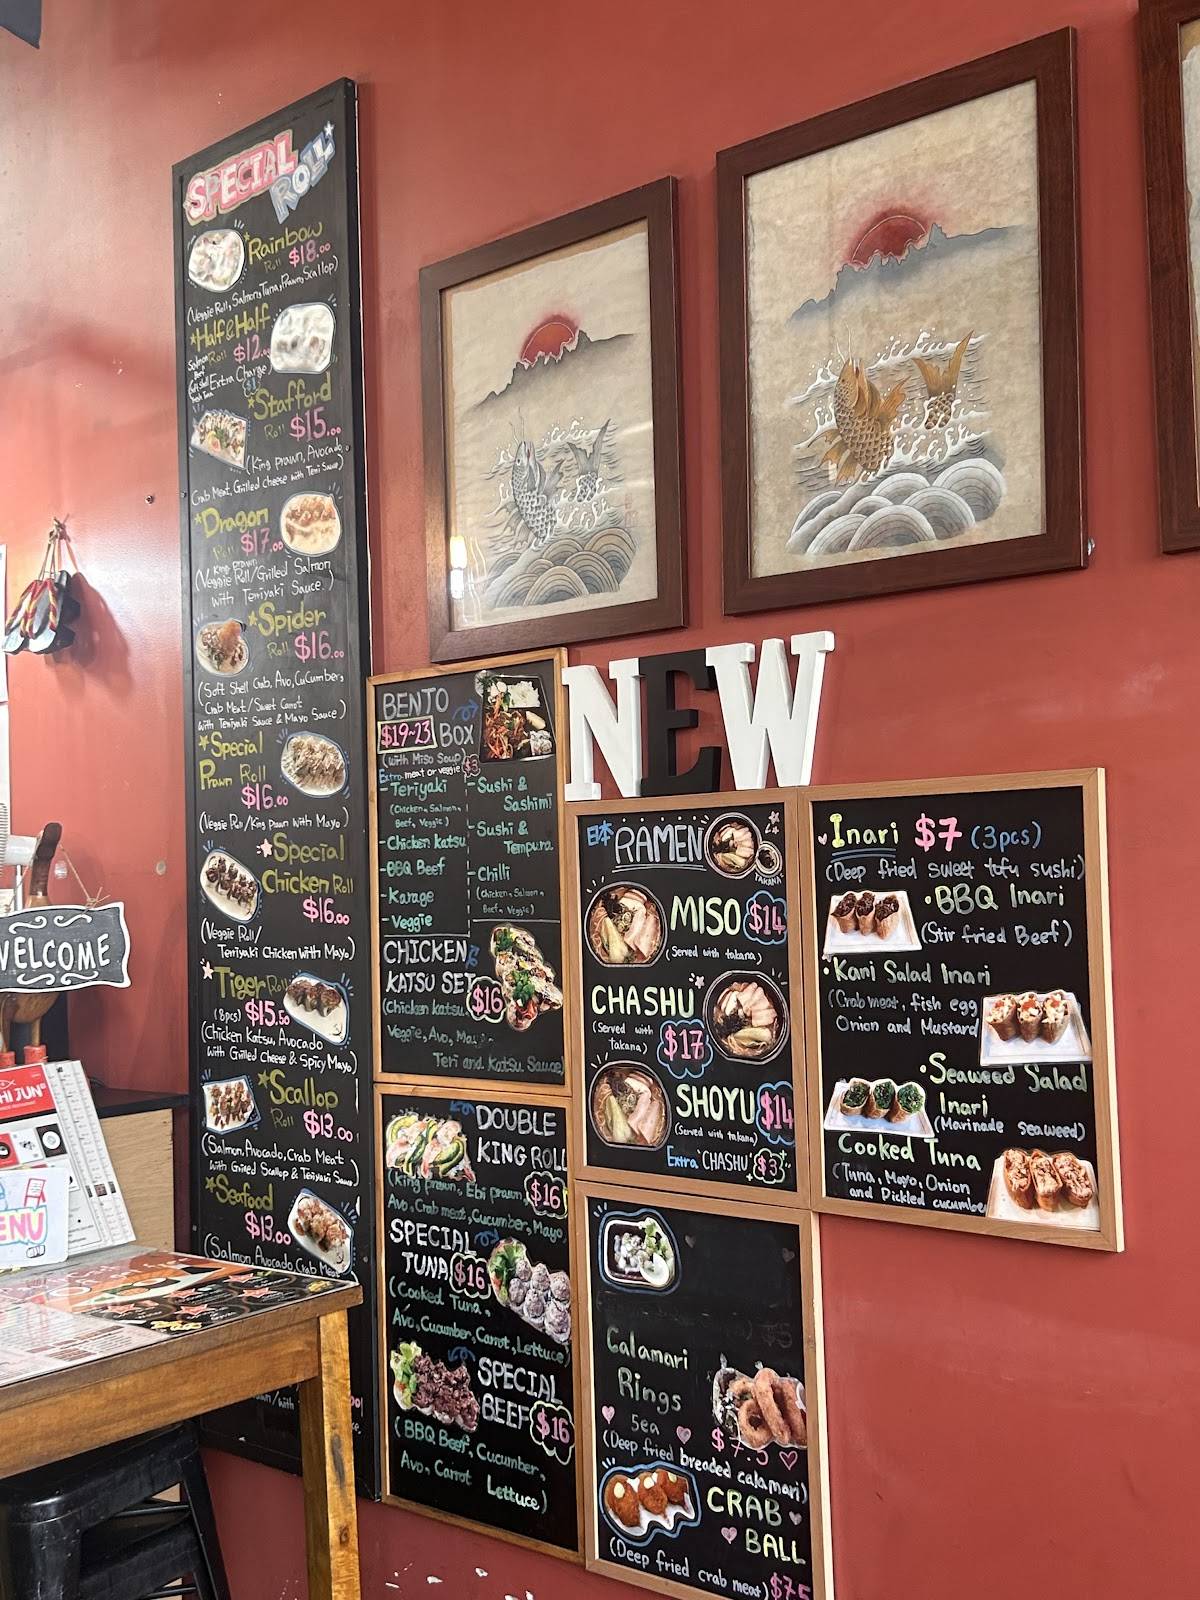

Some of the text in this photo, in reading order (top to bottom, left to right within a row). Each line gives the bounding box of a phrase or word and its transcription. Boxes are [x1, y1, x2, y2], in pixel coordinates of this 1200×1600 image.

[187, 134, 298, 221] SPECIAL
[249, 221, 323, 264] Rainbow
[209, 373, 235, 391] Extra
[253, 371, 331, 420] Stafford
[264, 423, 285, 440] Roll
[202, 507, 269, 538] Dragon
[293, 556, 331, 576] Salmon
[211, 582, 285, 608] with Teriyaki
[257, 601, 327, 637] Spider
[266, 630, 345, 664] Roll $16.00
[229, 677, 250, 695] Shell
[251, 712, 309, 727] Sauce & Mayo
[382, 687, 450, 721] BENTO
[561, 630, 835, 802] NEW
[210, 730, 264, 761] Special
[439, 722, 475, 748] BOX
[382, 747, 466, 769] (with Miso Soup)
[403, 757, 479, 780] meat or veggie $3
[199, 758, 267, 791] Prawn Roll
[390, 777, 448, 801] Teriyaki
[476, 775, 528, 795] Sushi &
[241, 782, 289, 811] $16.00
[503, 792, 553, 812] Sashimi
[476, 820, 529, 837] Sushi &
[586, 819, 615, 847] 日本
[614, 823, 705, 865] RAMEN
[829, 812, 1042, 852] Inari $7 (3pcs)
[272, 831, 345, 865] Special
[503, 839, 554, 857] Tempura
[261, 868, 354, 896] Chicken Roll
[386, 856, 446, 878] BBQ Beef
[477, 864, 511, 882] Chilli
[825, 854, 1085, 884] (Deep fried sweet tofu sushi)
[302, 895, 351, 926] $16.00
[387, 886, 435, 908] Karage
[934, 882, 1065, 916] BBQ Inari
[391, 912, 434, 933] Veggie
[670, 894, 787, 937] MISO $14
[920, 919, 1073, 948] (Stir fried Beef)
[216, 943, 321, 961] Teriyaki Chicken with
[382, 939, 468, 965] CHICKEN
[665, 945, 720, 962] (Served with
[213, 966, 289, 1000] Tiger Roll
[832, 956, 992, 987] Kani Salad Inari
[385, 970, 504, 1016] KATSU SET $16
[591, 984, 695, 1019] CHASHU
[908, 991, 979, 1018] fish egg
[244, 998, 291, 1027] $15.50
[592, 1020, 654, 1036] (Served with
[835, 1014, 980, 1039] Onion and Mustard
[201, 1020, 324, 1051] (Chicken Avocado
[663, 1024, 705, 1062] $17
[206, 1045, 327, 1074] with Grilled Cheese & Spicy
[432, 1052, 459, 1069] Teri
[928, 1051, 1089, 1094] Seaweed Salad
[269, 1068, 339, 1110] Scallop
[938, 1091, 989, 1118] Inari
[475, 1104, 557, 1137] DOUBLE
[675, 1082, 795, 1131] SHOYU $14
[270, 1107, 354, 1142] Roll $13.00
[707, 1127, 724, 1140] with
[933, 1117, 1086, 1143] (Marinade seaweed)
[286, 1148, 345, 1166] Crab Meat
[476, 1137, 568, 1172] KING ROLL
[666, 1145, 779, 1178] Extra $3
[837, 1131, 982, 1173] Cooked Tuna
[290, 1167, 299, 1179] &
[924, 1172, 972, 1196] Onion
[216, 1173, 274, 1211] Seafood
[414, 1199, 440, 1215] Crab
[465, 1178, 561, 1210] Ebi $16
[849, 1184, 875, 1201] and
[244, 1210, 292, 1245] $13.00
[388, 1217, 478, 1257] SPECIAL
[401, 1251, 486, 1291] TUNA $16
[388, 1275, 445, 1306] (Cooked
[516, 1335, 571, 1368] Lettuce)
[606, 1326, 689, 1371] Calamari
[477, 1356, 564, 1406] SPECIAL
[617, 1366, 683, 1416] Rings
[481, 1392, 571, 1445] BEEF $16
[602, 1428, 808, 1506] (Deep fried breaded calamari)
[434, 1459, 548, 1515] Carrot Lettuce)
[706, 1485, 783, 1528] CRAB
[745, 1526, 806, 1566] BALL
[609, 1535, 728, 1589] (Deep fried crab
